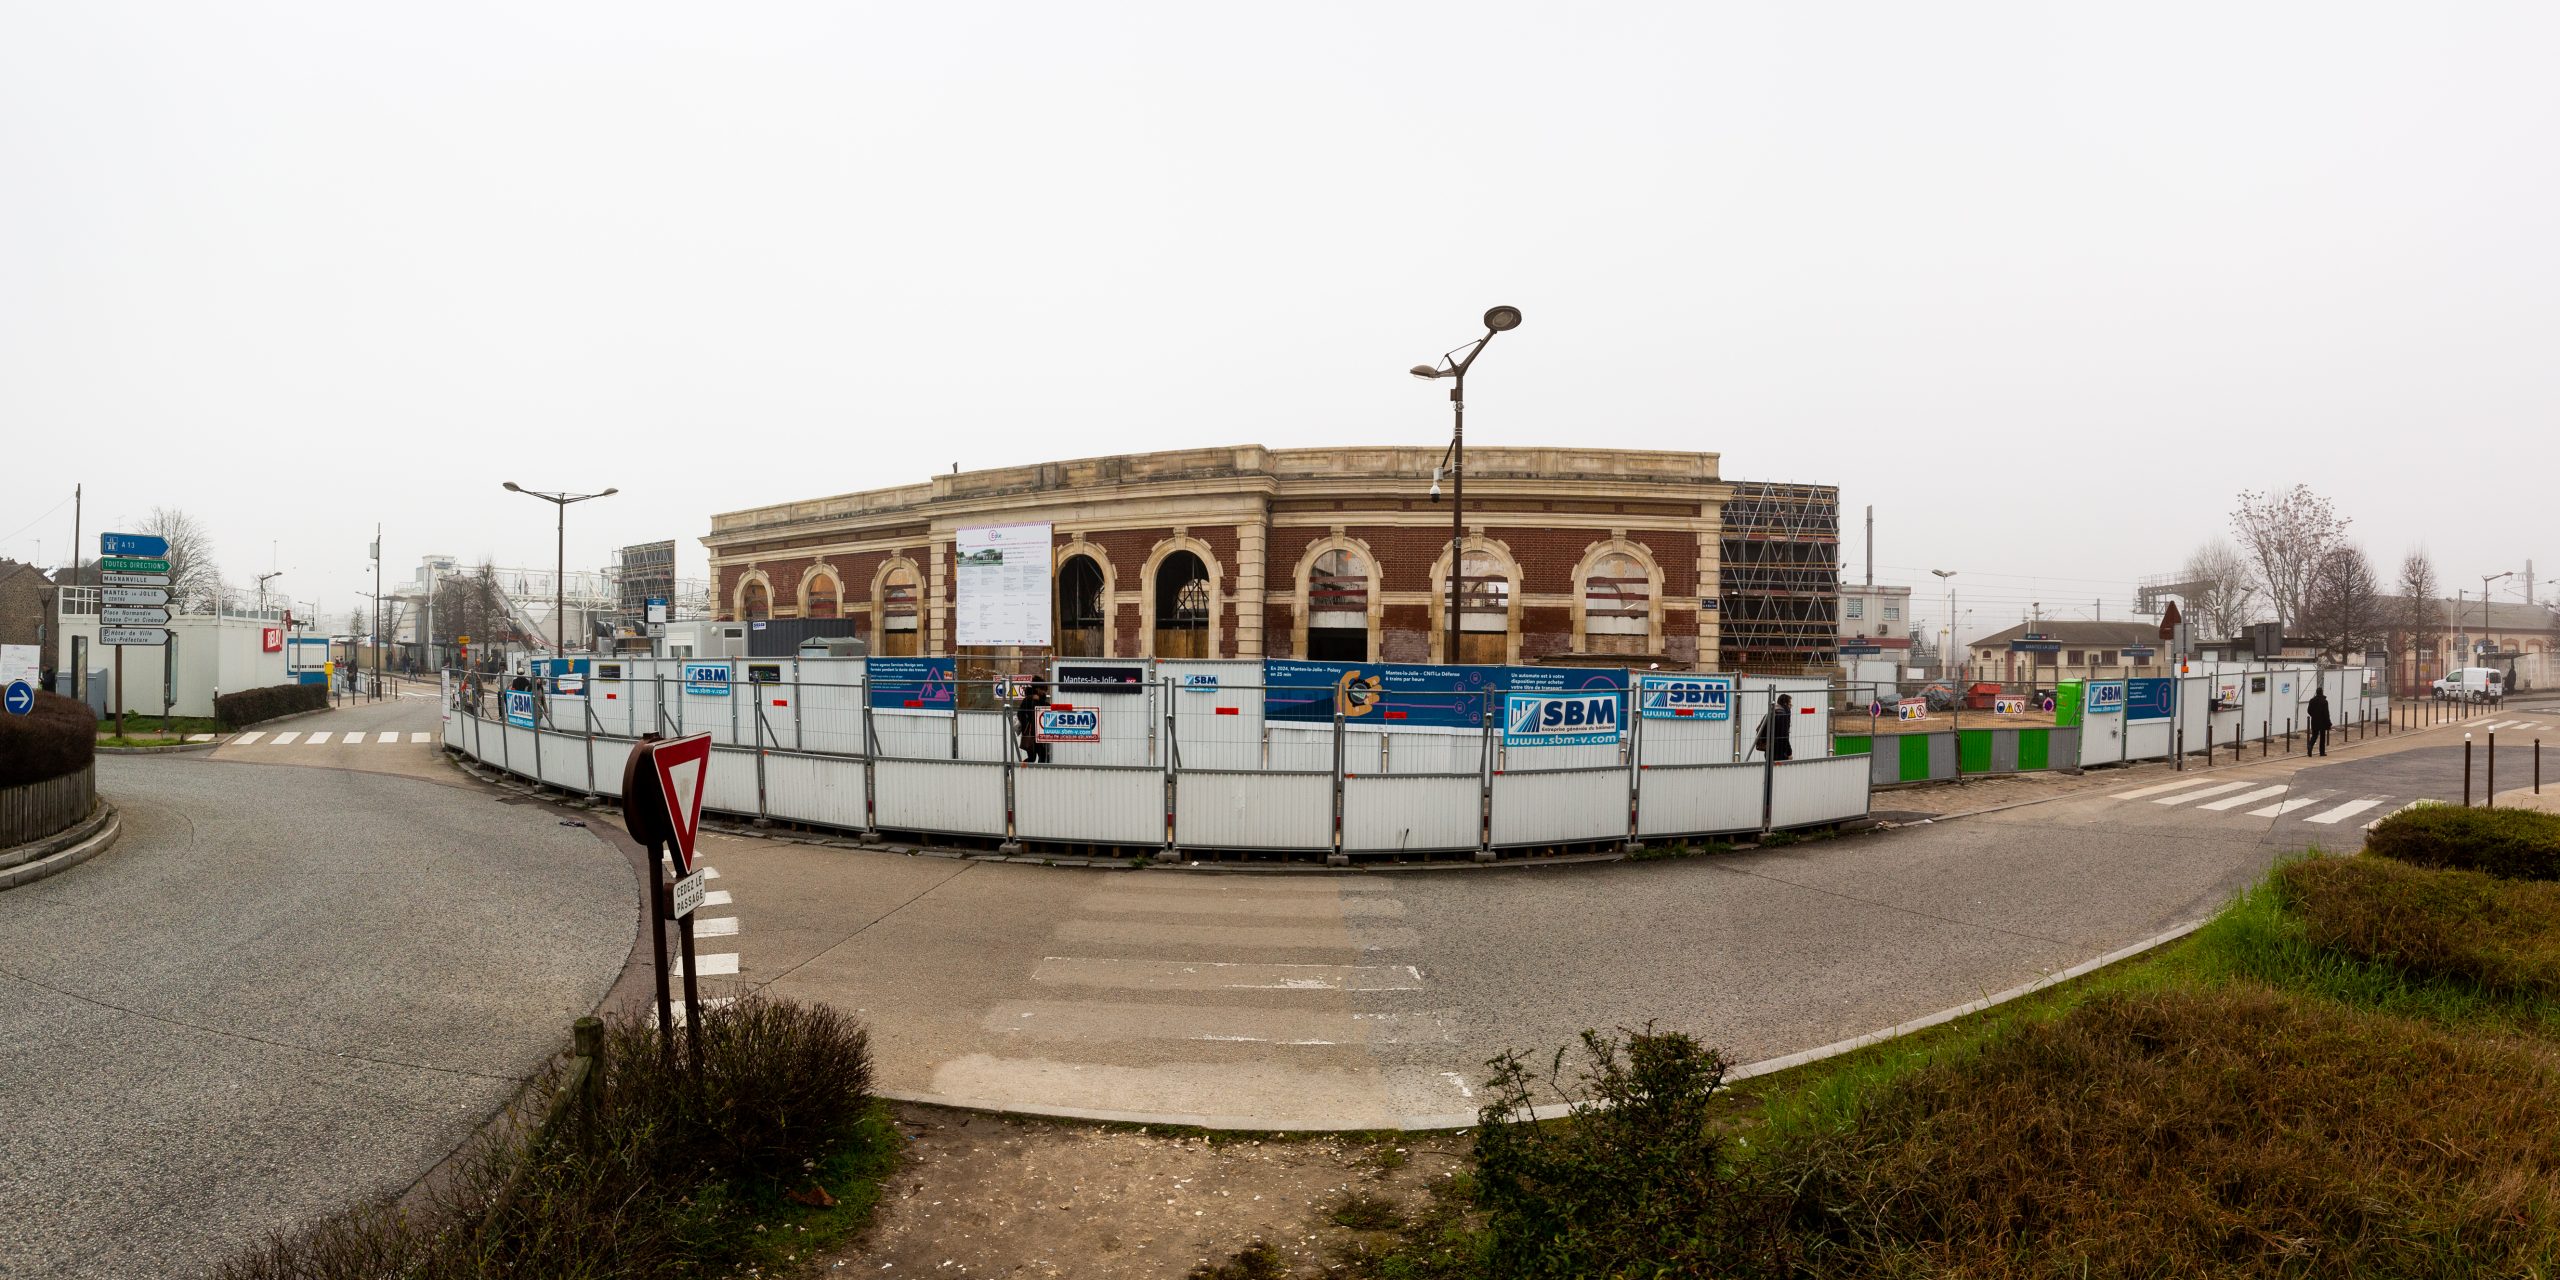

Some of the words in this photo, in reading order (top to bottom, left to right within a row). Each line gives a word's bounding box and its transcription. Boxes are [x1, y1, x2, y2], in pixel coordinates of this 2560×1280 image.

[127, 541, 135, 549] 13
[105, 560, 128, 568] TOUTES
[129, 562, 166, 570] DIRECTIONS
[103, 575, 147, 583] MAGNANVILLE
[697, 668, 727, 681] SBM
[1194, 676, 1217, 684] SBM
[1669, 682, 1726, 704] SBM
[2101, 686, 2121, 701] SBM
[514, 694, 532, 713] SBM
[1542, 699, 1616, 726] SBM
[1058, 714, 1090, 725] SBM
[1506, 735, 1617, 745] www.sbm-v.com
[676, 879, 694, 898] CEDEZ
[695, 875, 702, 887] LE
[676, 888, 703, 914] PASSAGE
